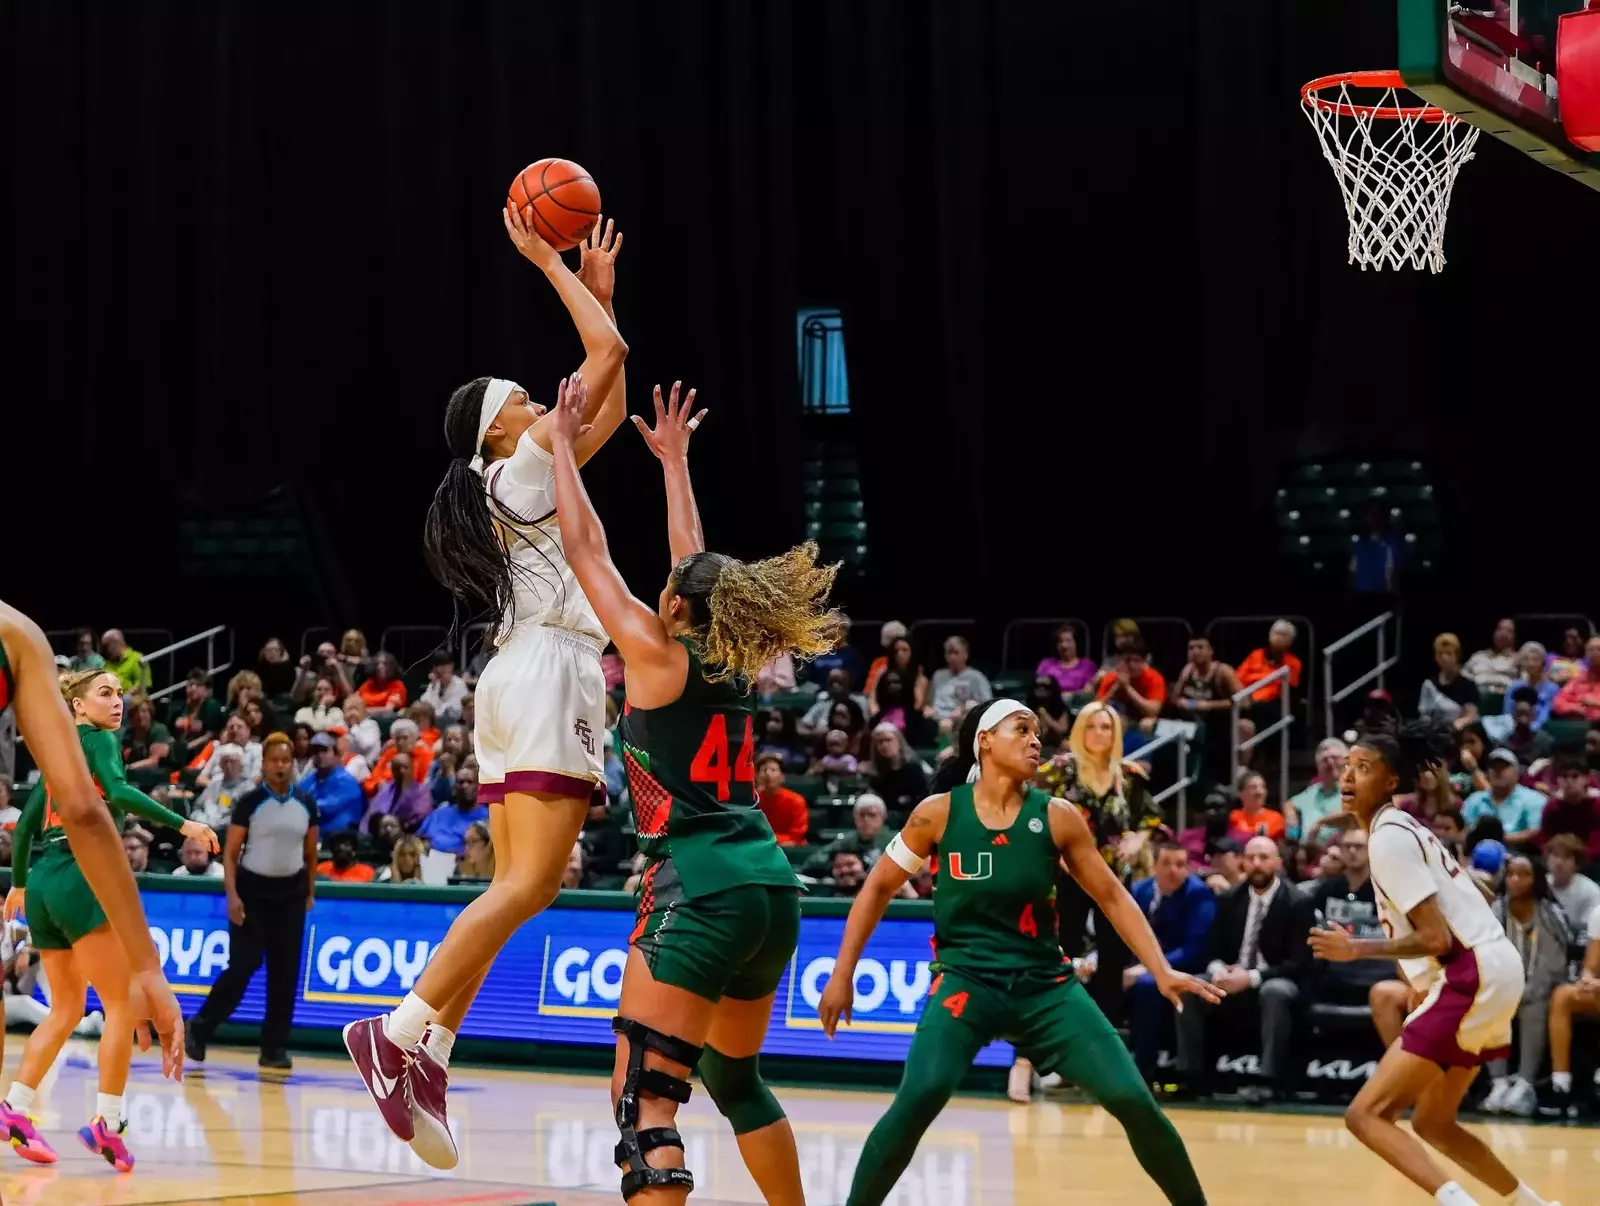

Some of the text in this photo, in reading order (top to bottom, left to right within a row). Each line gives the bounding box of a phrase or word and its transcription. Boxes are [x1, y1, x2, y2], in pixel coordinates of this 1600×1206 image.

[574, 718, 596, 756] FSU
[949, 852, 992, 880] U
[1019, 903, 1038, 938] 4
[317, 936, 442, 991] GOY
[552, 946, 628, 1005] GO
[942, 991, 970, 1018] 4
